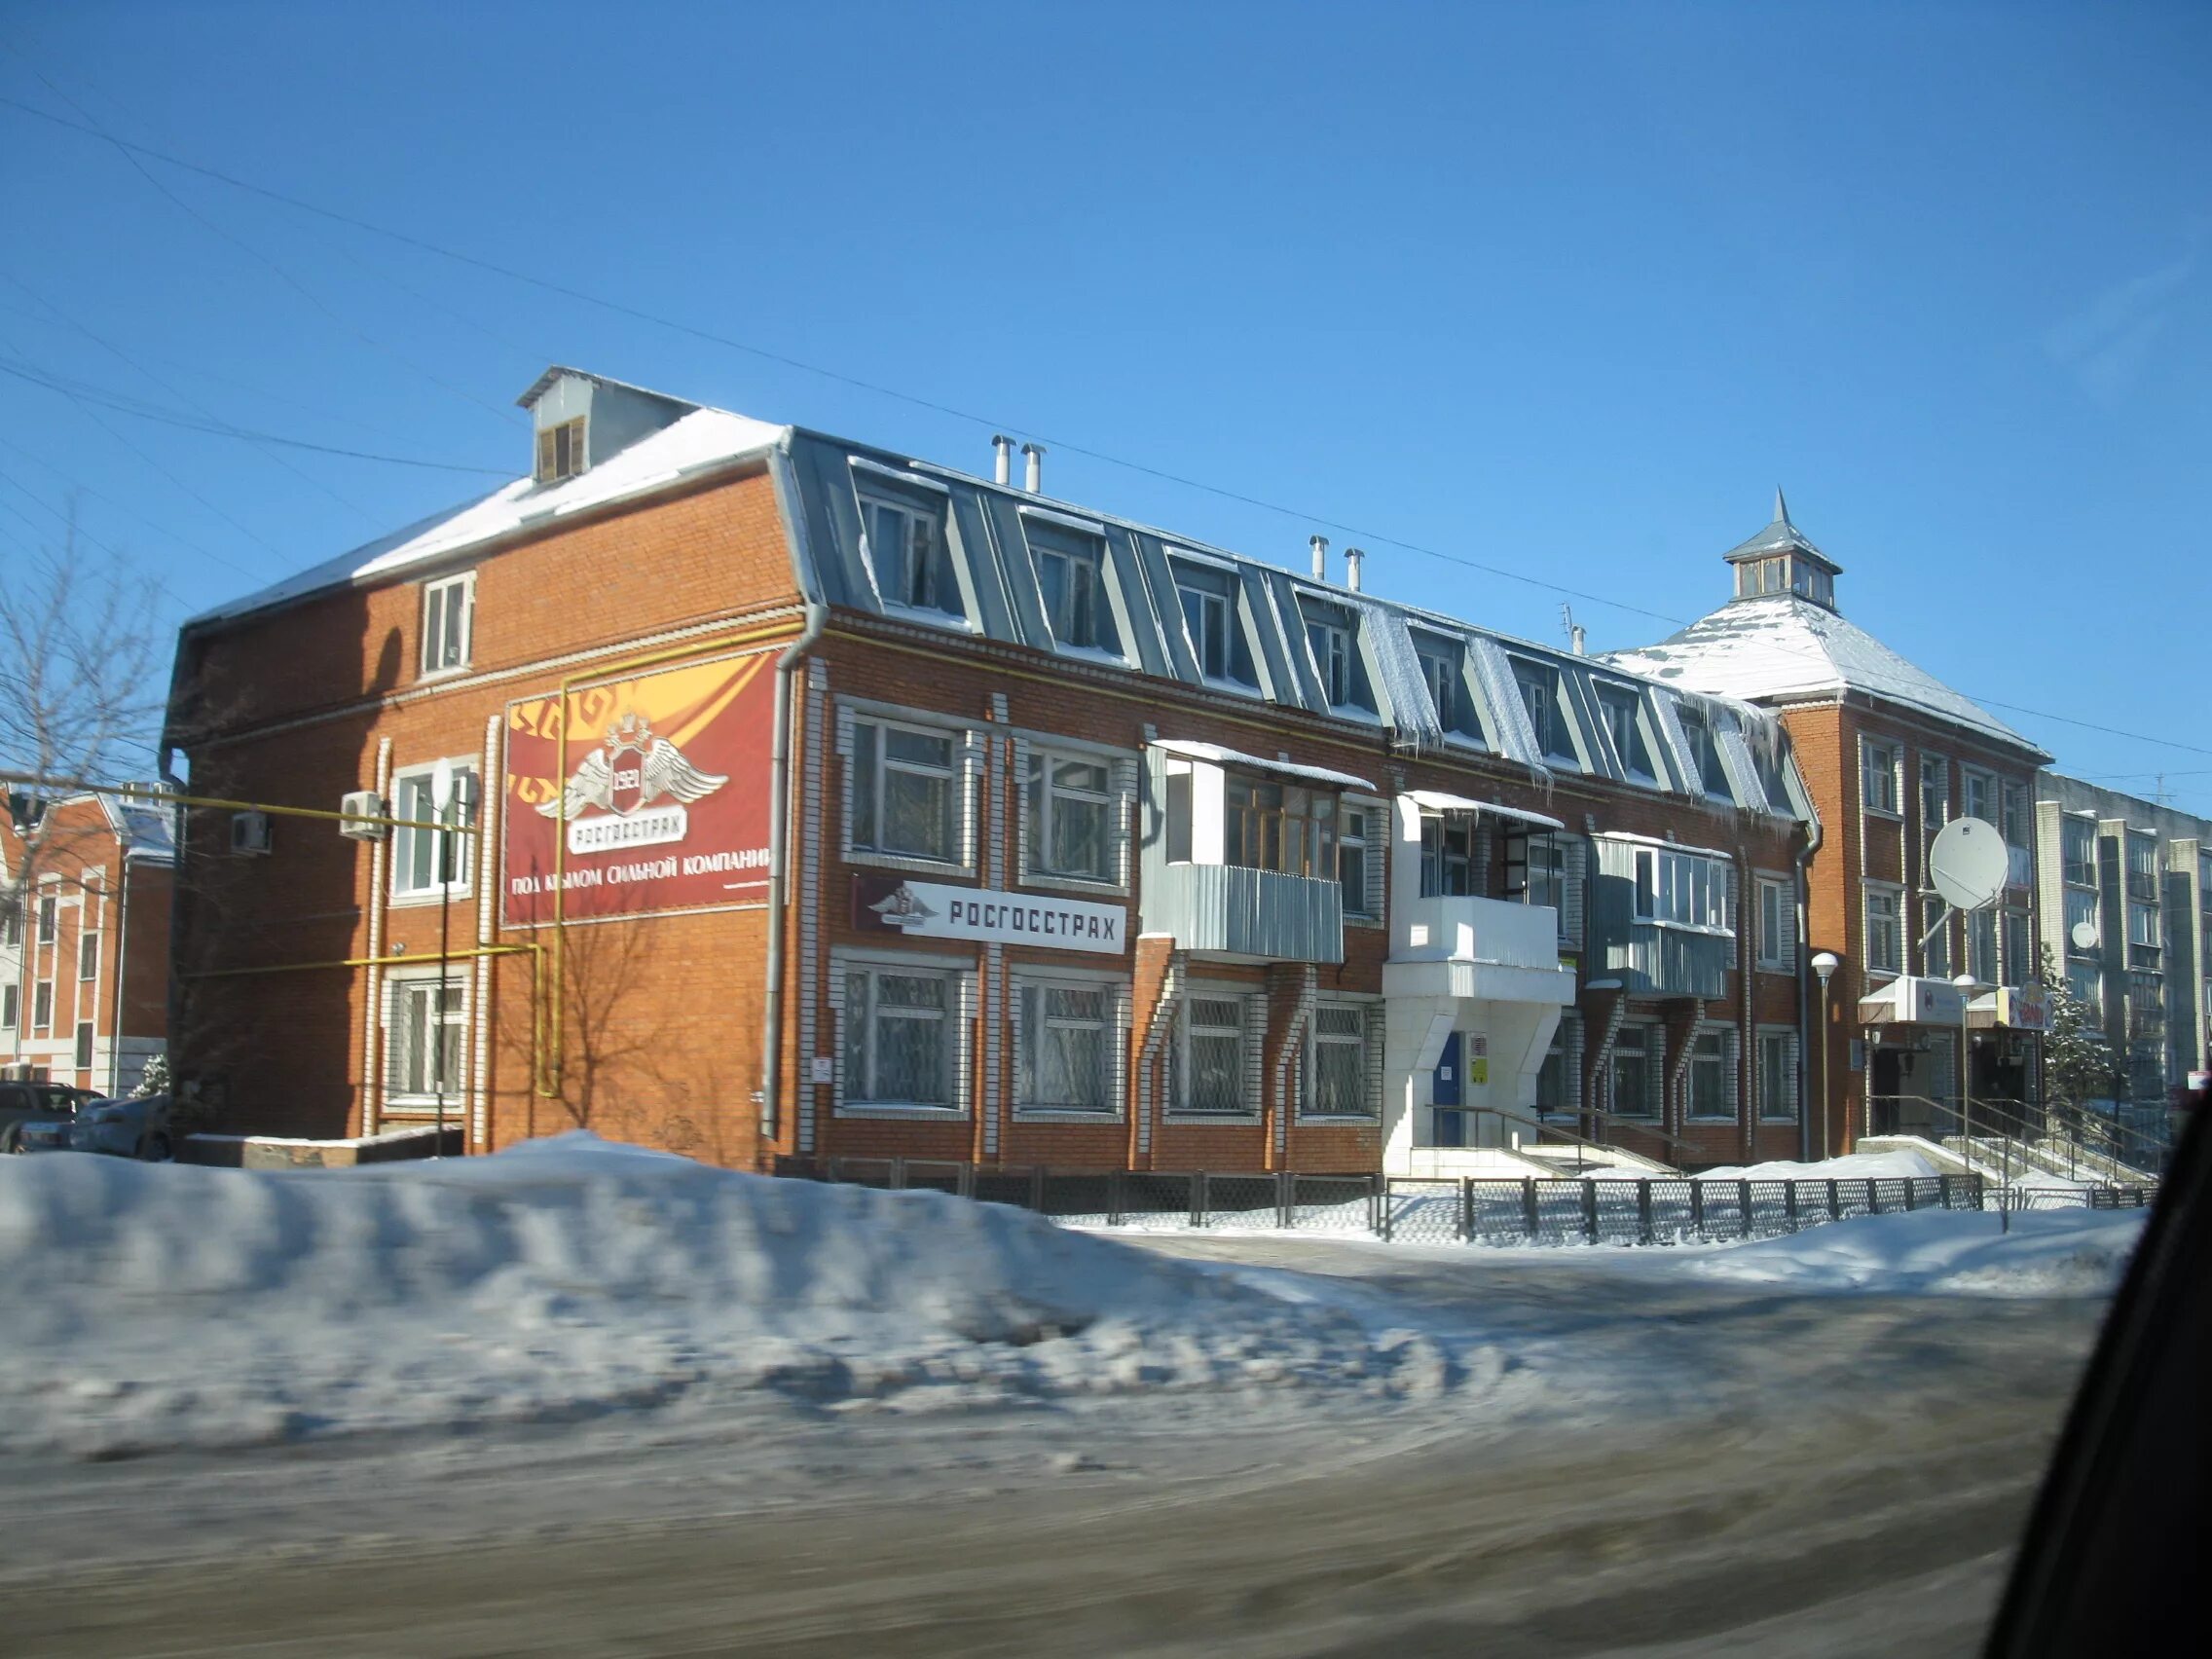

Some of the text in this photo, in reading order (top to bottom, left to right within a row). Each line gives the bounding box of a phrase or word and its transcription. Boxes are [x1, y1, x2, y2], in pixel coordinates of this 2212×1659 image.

[575, 816, 681, 846] РОСГОССТРАХ
[607, 856, 678, 884] СИЛЬНОЙ
[949, 900, 1116, 940] РОСГОССТРАХ
